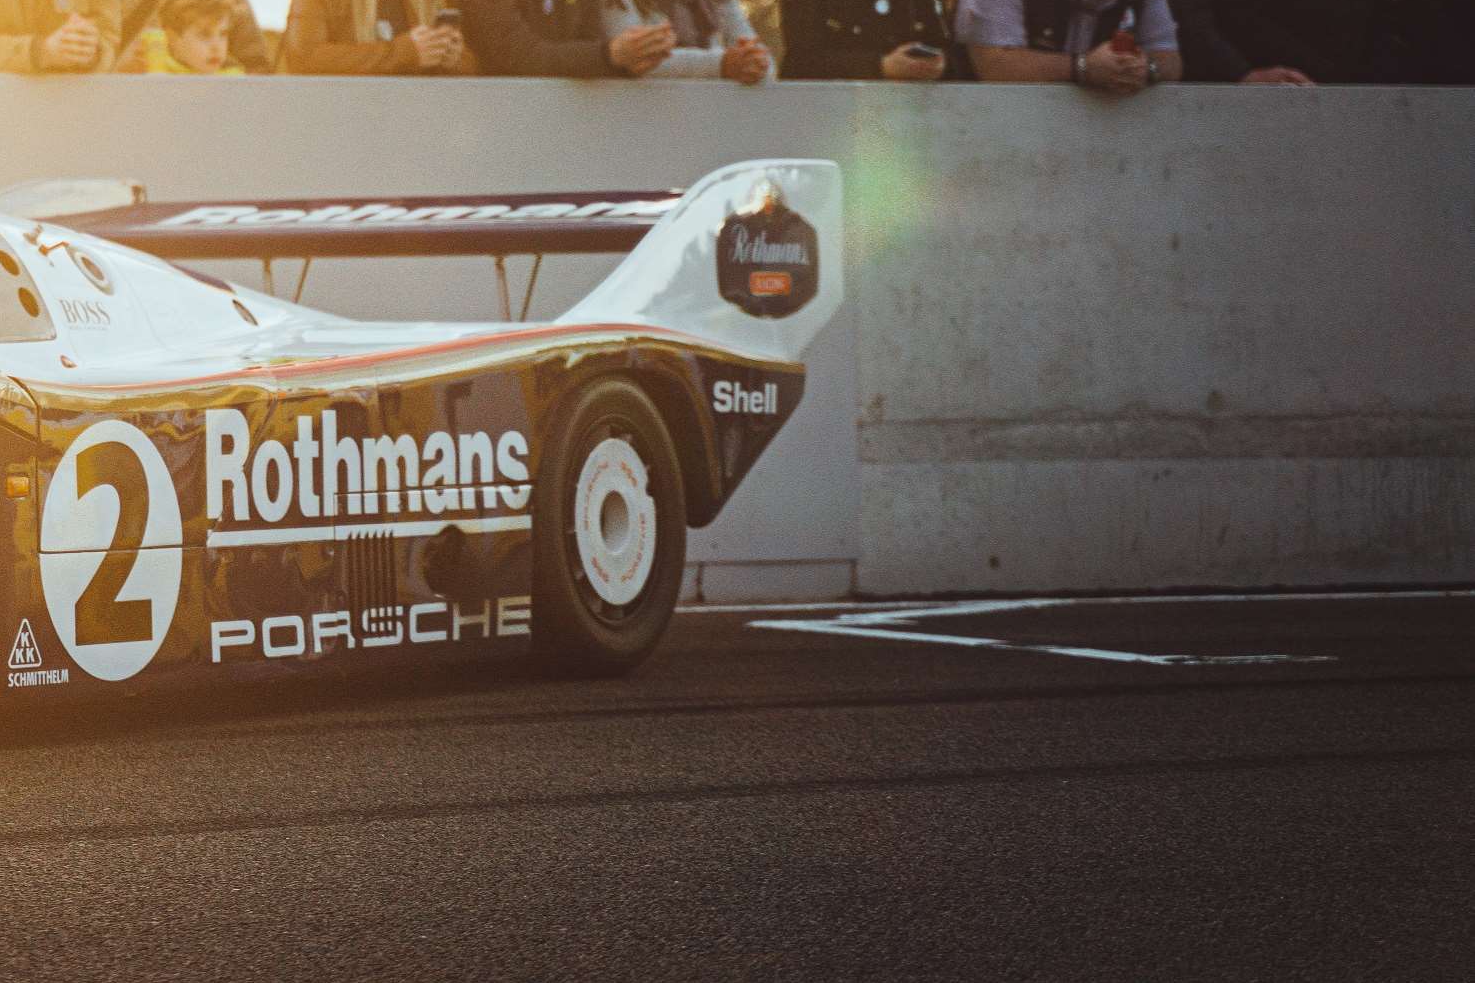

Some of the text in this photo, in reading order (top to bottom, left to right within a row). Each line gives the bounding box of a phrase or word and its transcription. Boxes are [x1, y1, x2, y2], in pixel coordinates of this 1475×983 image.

[59, 298, 111, 325] BOSS
[712, 380, 778, 414] Shell
[205, 408, 530, 523] Rothmans
[74, 439, 154, 647] 2
[210, 595, 532, 663] PORSCHE
[7, 669, 69, 688] SCHMITTHELM
